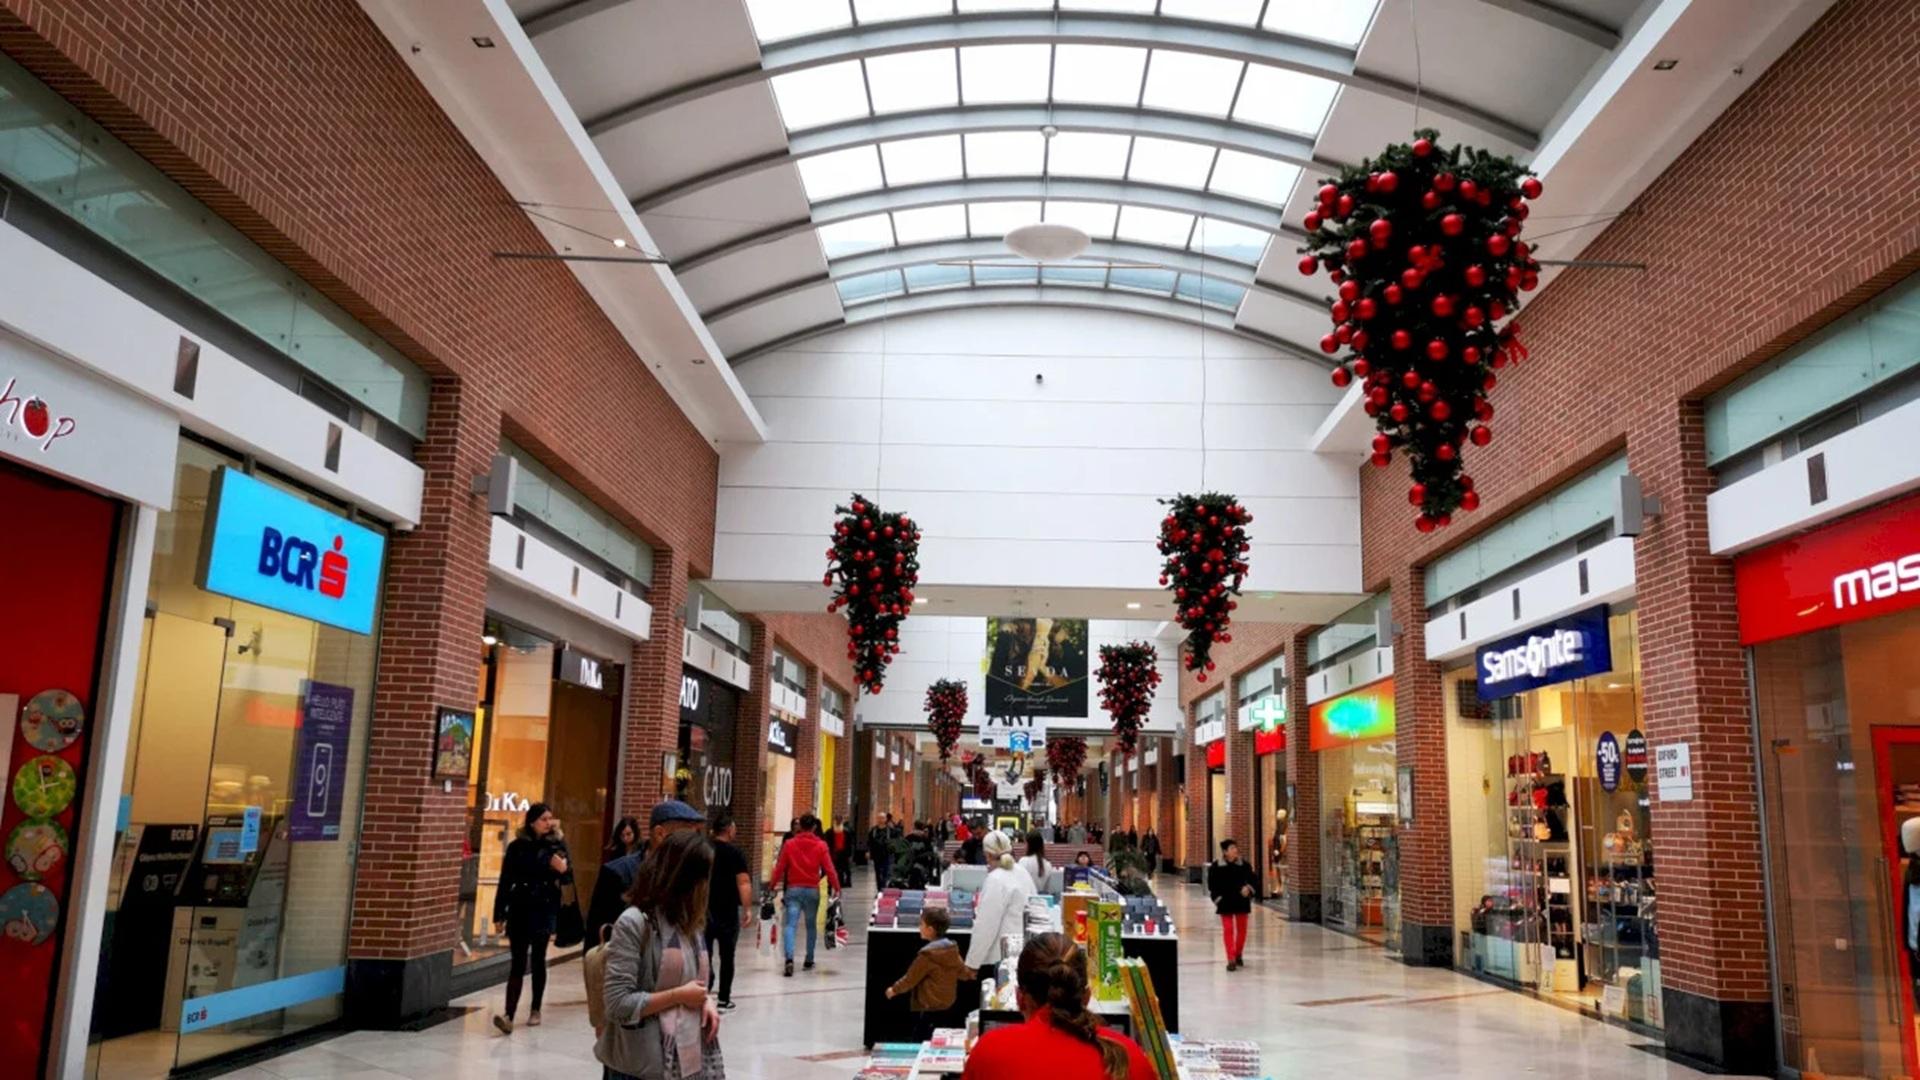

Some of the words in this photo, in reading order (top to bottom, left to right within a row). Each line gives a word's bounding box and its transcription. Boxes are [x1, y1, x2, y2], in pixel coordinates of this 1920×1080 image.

[258, 526, 319, 591] BCR
[1834, 553, 1920, 609] mas
[1483, 629, 1583, 684] Samsonite
[1658, 749, 1678, 761] OXFORD
[1659, 767, 1677, 779] STREET
[703, 764, 732, 807] CATO
